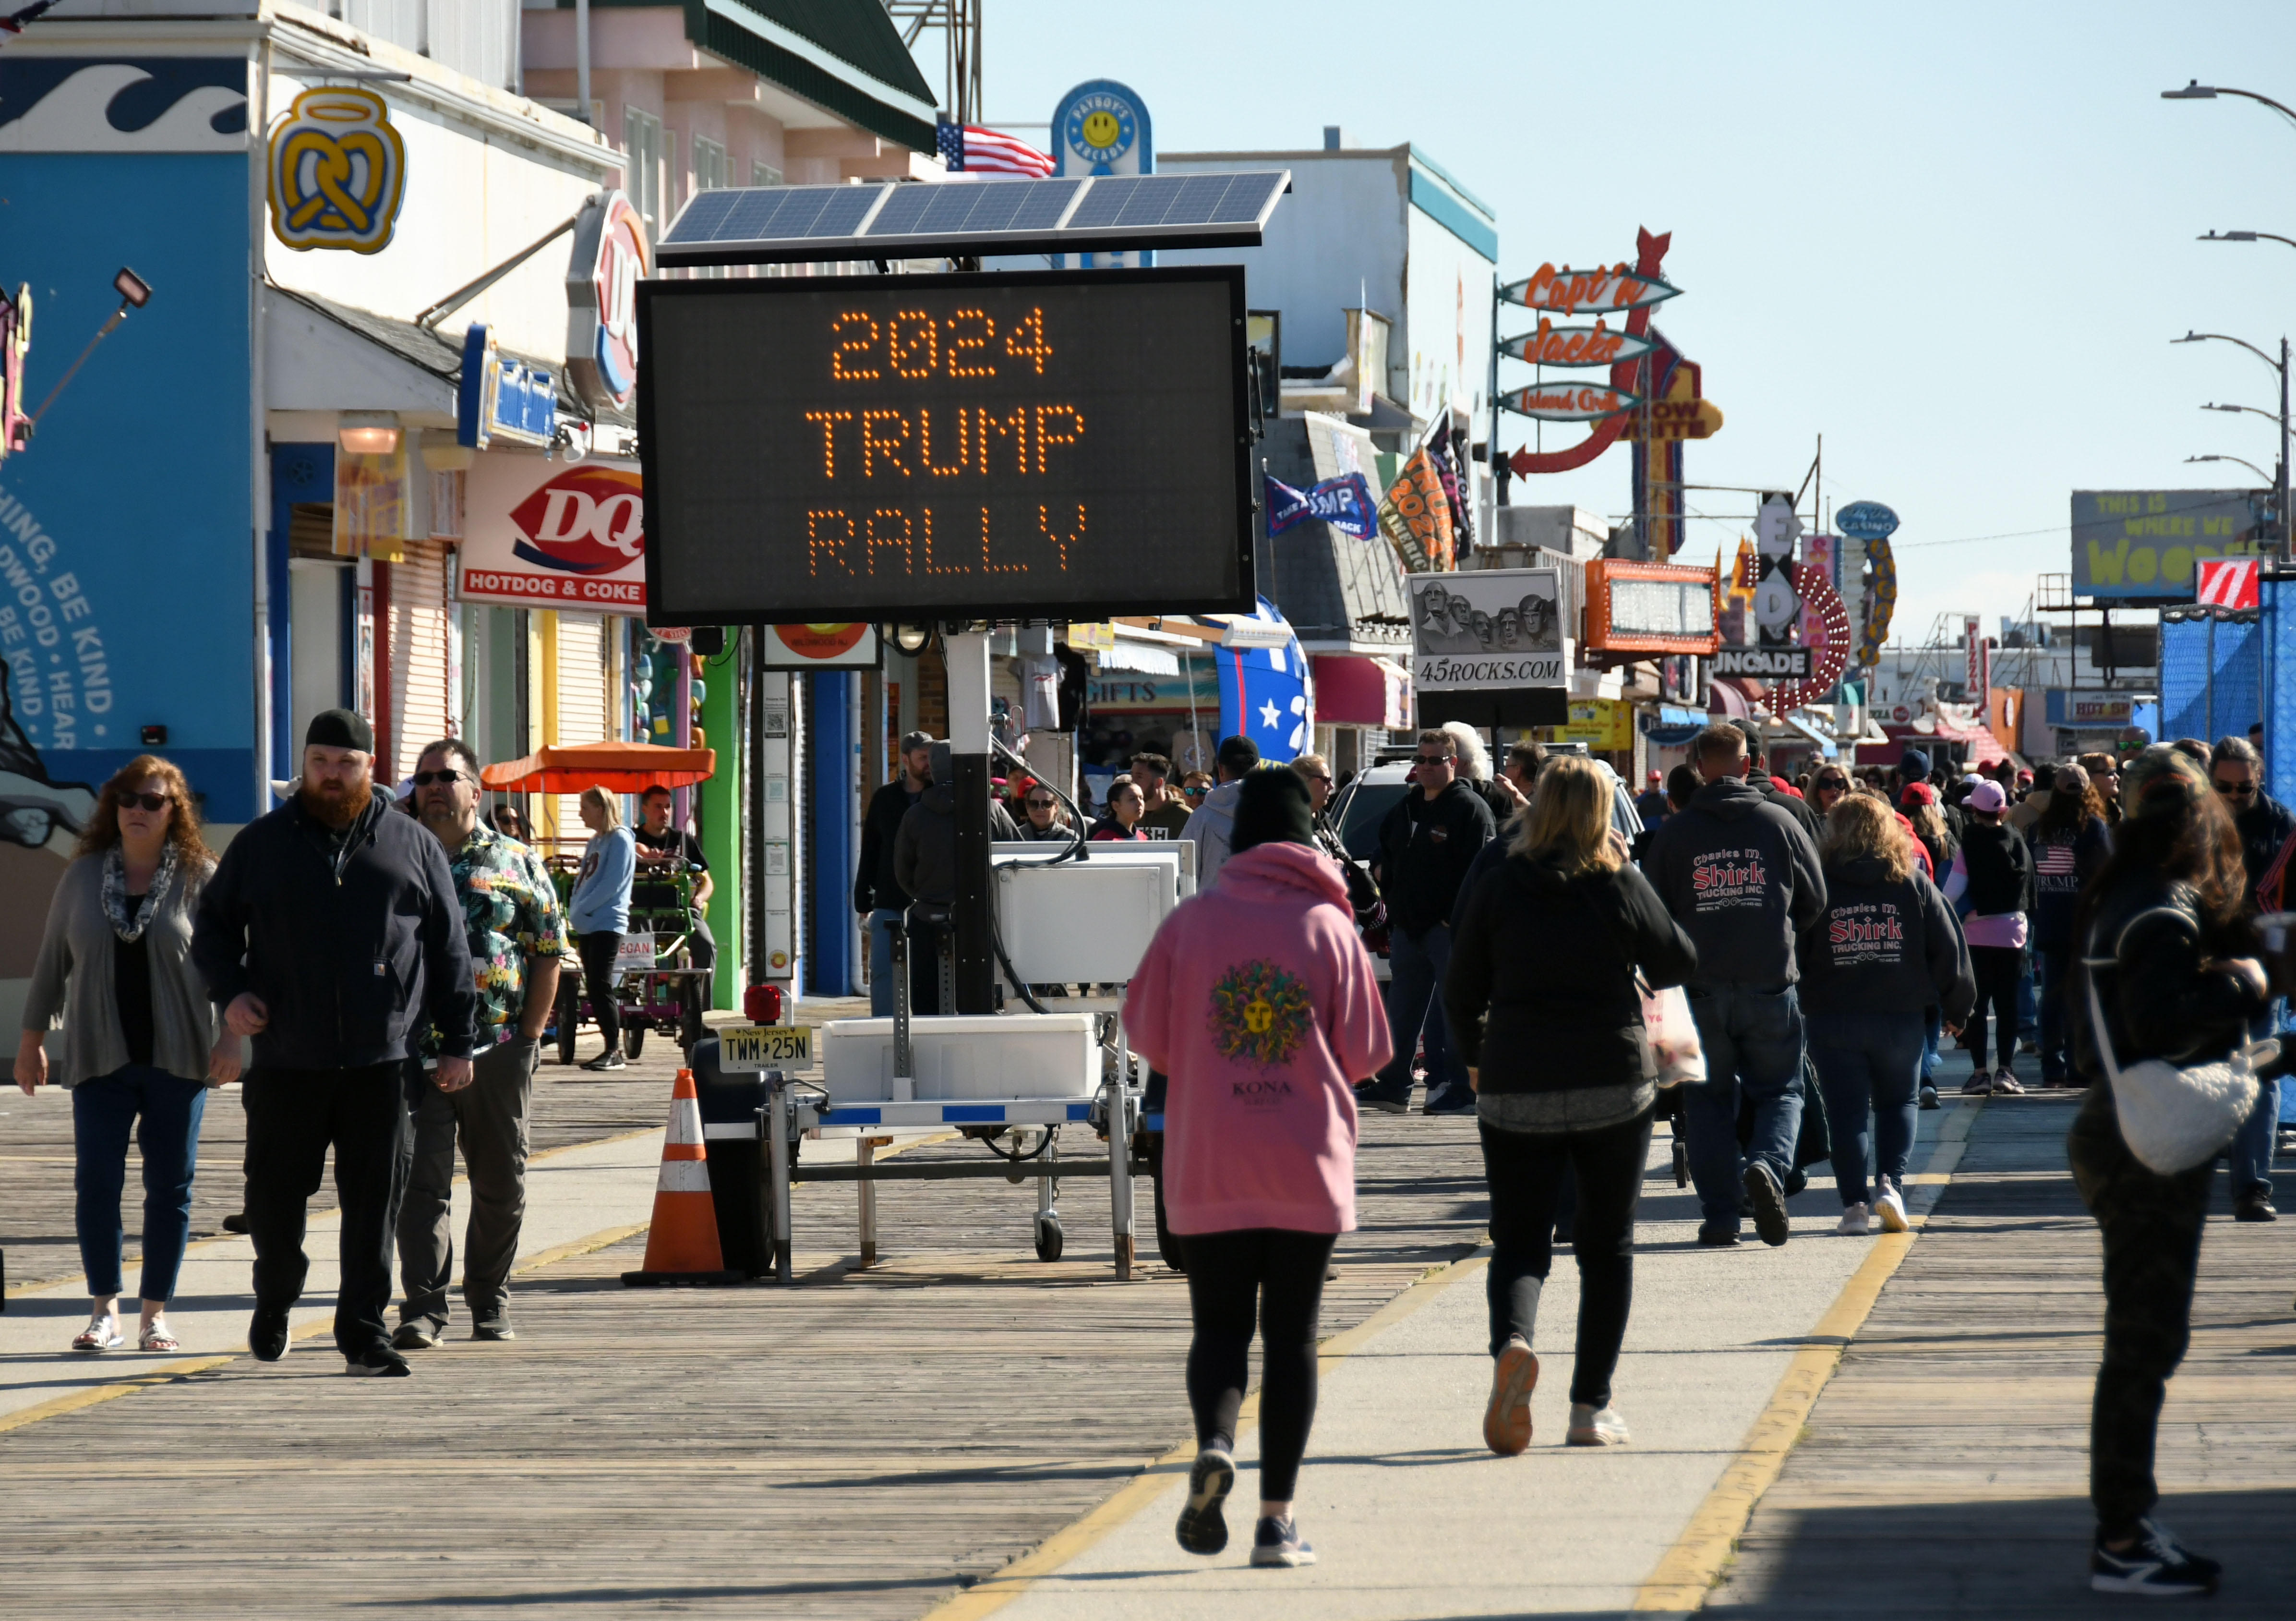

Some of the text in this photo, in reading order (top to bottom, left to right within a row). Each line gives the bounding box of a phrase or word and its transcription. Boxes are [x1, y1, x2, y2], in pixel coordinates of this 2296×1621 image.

[1075, 141, 1125, 161] ARCADE
[1524, 262, 1649, 317] Capt'n
[832, 306, 1053, 379] 2024
[1523, 317, 1623, 363] Jacks
[1522, 388, 1621, 412] Island Grill
[805, 404, 1086, 477] TRUMP
[1276, 501, 1298, 520] TAKE
[1309, 486, 1354, 515] UMP
[2096, 494, 2167, 513] THIS IS
[534, 488, 643, 557] DQ
[1333, 520, 1361, 533] BACK
[1389, 478, 1444, 558] 2024
[2125, 516, 2234, 536] WHERE WE
[806, 503, 1087, 576] RALLY
[1385, 512, 1429, 570] AMERIC
[469, 573, 640, 601] HOTDOG & COKE
[49, 572, 91, 623] BE
[71, 626, 113, 714] KIND
[1419, 657, 1561, 683] 45ROCKS.COM
[1968, 622, 1978, 692] PIZZA
[11, 647, 42, 716] KIND
[1086, 681, 1157, 703] GIFTS
[1693, 848, 1740, 867] Charles
[1693, 860, 1767, 890] Shirk
[2035, 875, 2079, 888] TRUMP
[1745, 885, 1765, 895] INC.
[1831, 903, 1877, 919] Charles
[1829, 916, 1903, 943] Shirk
[1831, 941, 1902, 954] TRUCKING INC.
[742, 1028, 789, 1037] New Jersey
[725, 1036, 806, 1061] TWM 25N
[1232, 1081, 1292, 1096] KONA
